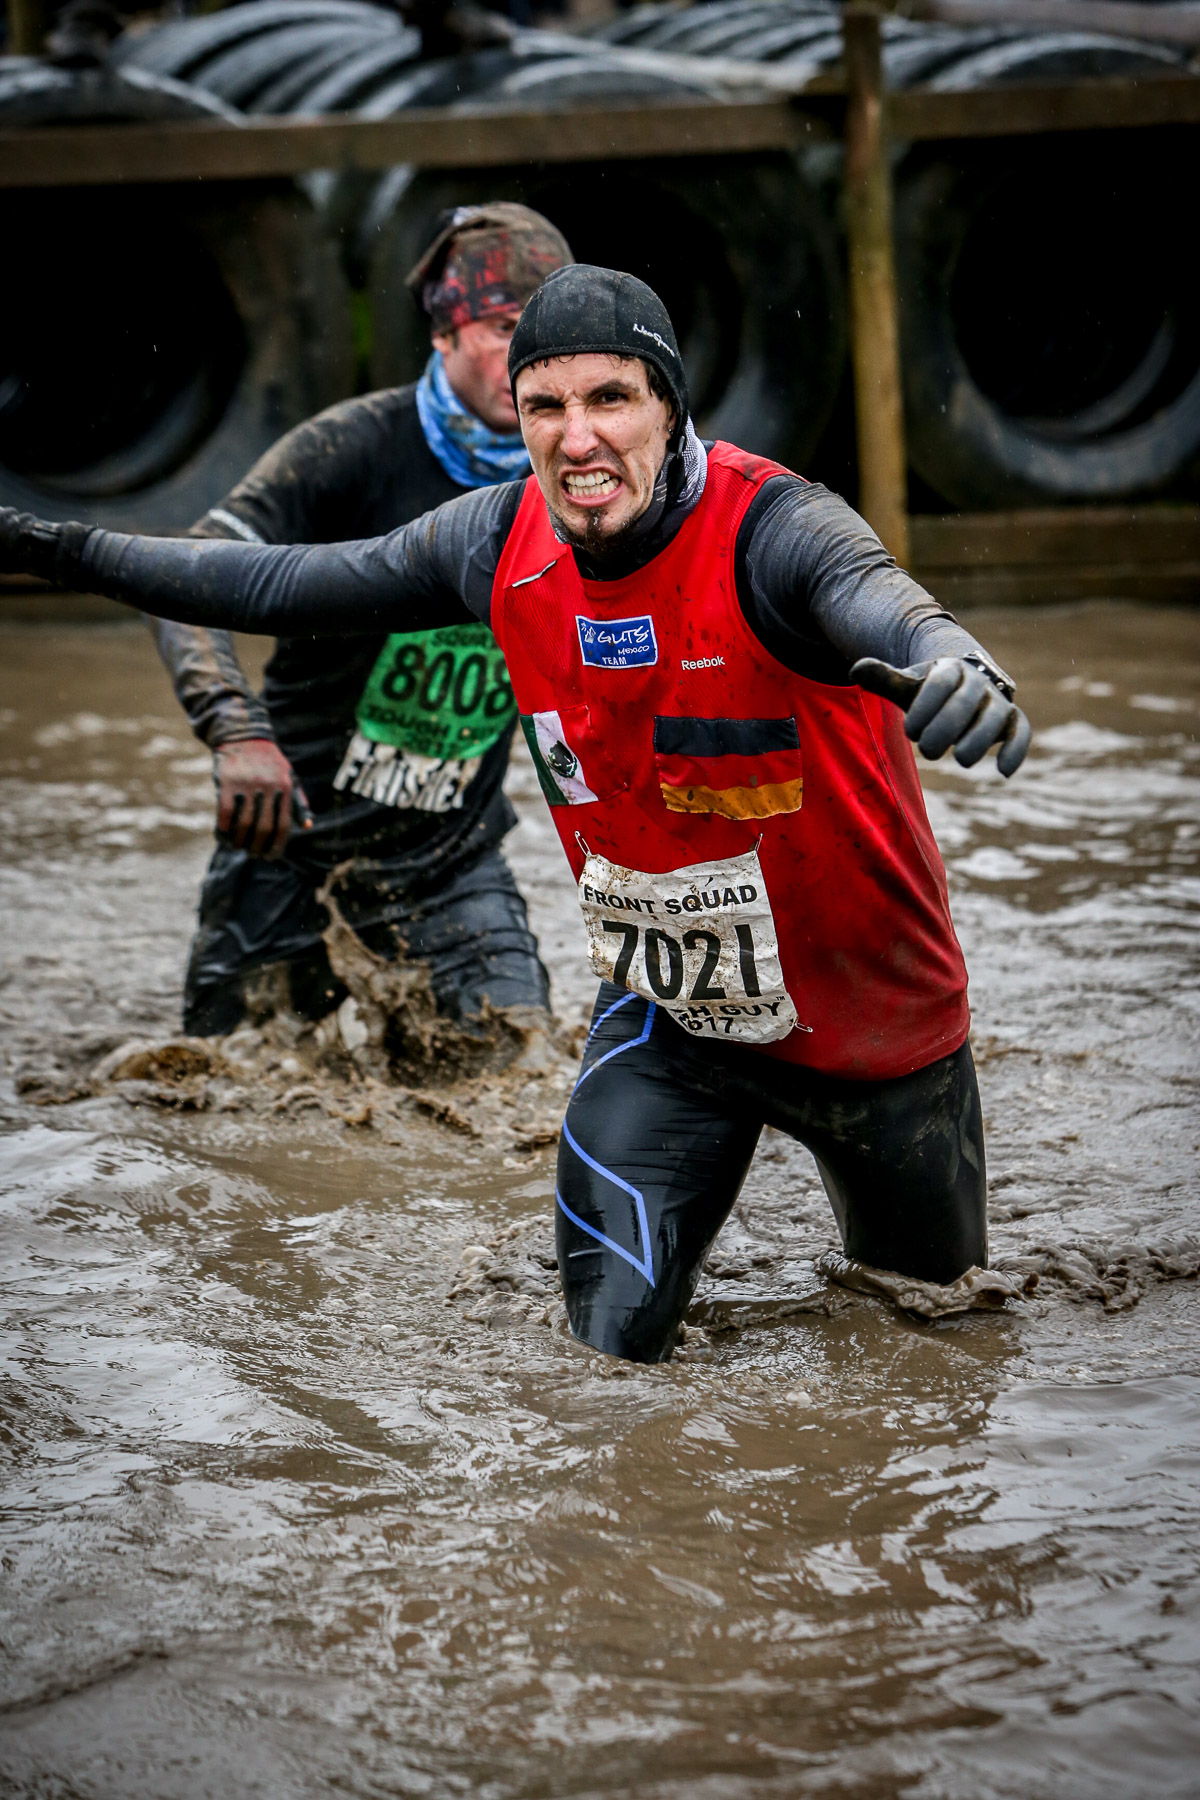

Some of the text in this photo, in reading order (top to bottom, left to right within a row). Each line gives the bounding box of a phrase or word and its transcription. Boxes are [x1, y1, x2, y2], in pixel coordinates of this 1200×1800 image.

[596, 625, 651, 644] GUTS
[602, 656, 628, 666] TEAM
[681, 655, 726, 671] Reebok
[382, 643, 515, 718] 8008
[583, 883, 758, 915] FRONT SQUAD
[601, 919, 763, 1001] 7021
[718, 1001, 781, 1017] GUY
